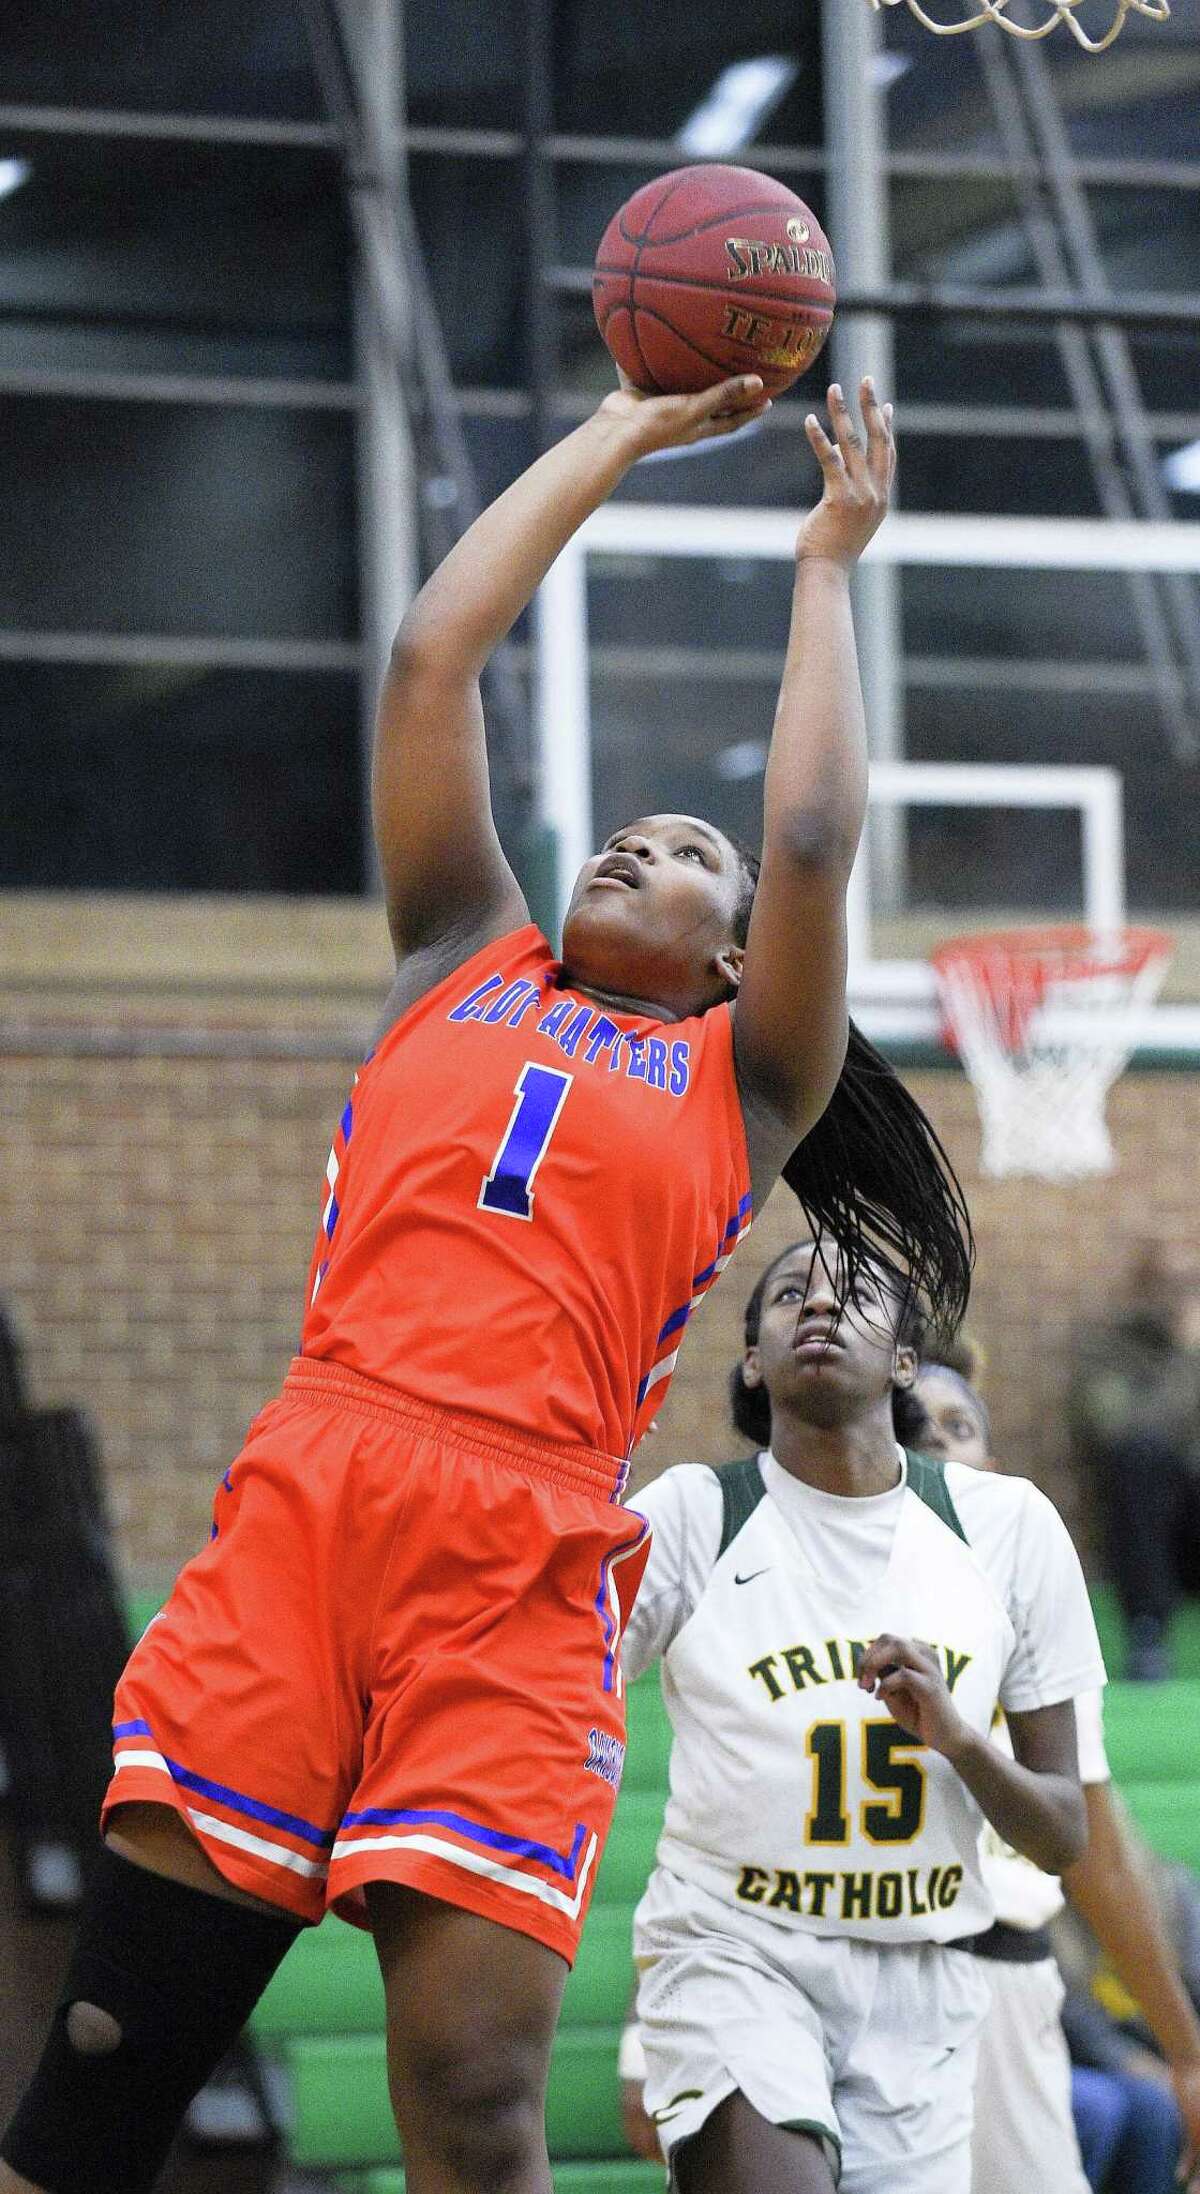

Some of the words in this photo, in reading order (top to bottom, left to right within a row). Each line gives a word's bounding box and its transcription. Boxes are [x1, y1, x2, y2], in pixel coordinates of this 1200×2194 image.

[477, 1061, 575, 1221] 1
[748, 1637, 973, 1702] TRIY
[804, 1718, 928, 1847] 15
[736, 1863, 964, 1920] CATHOLIC
